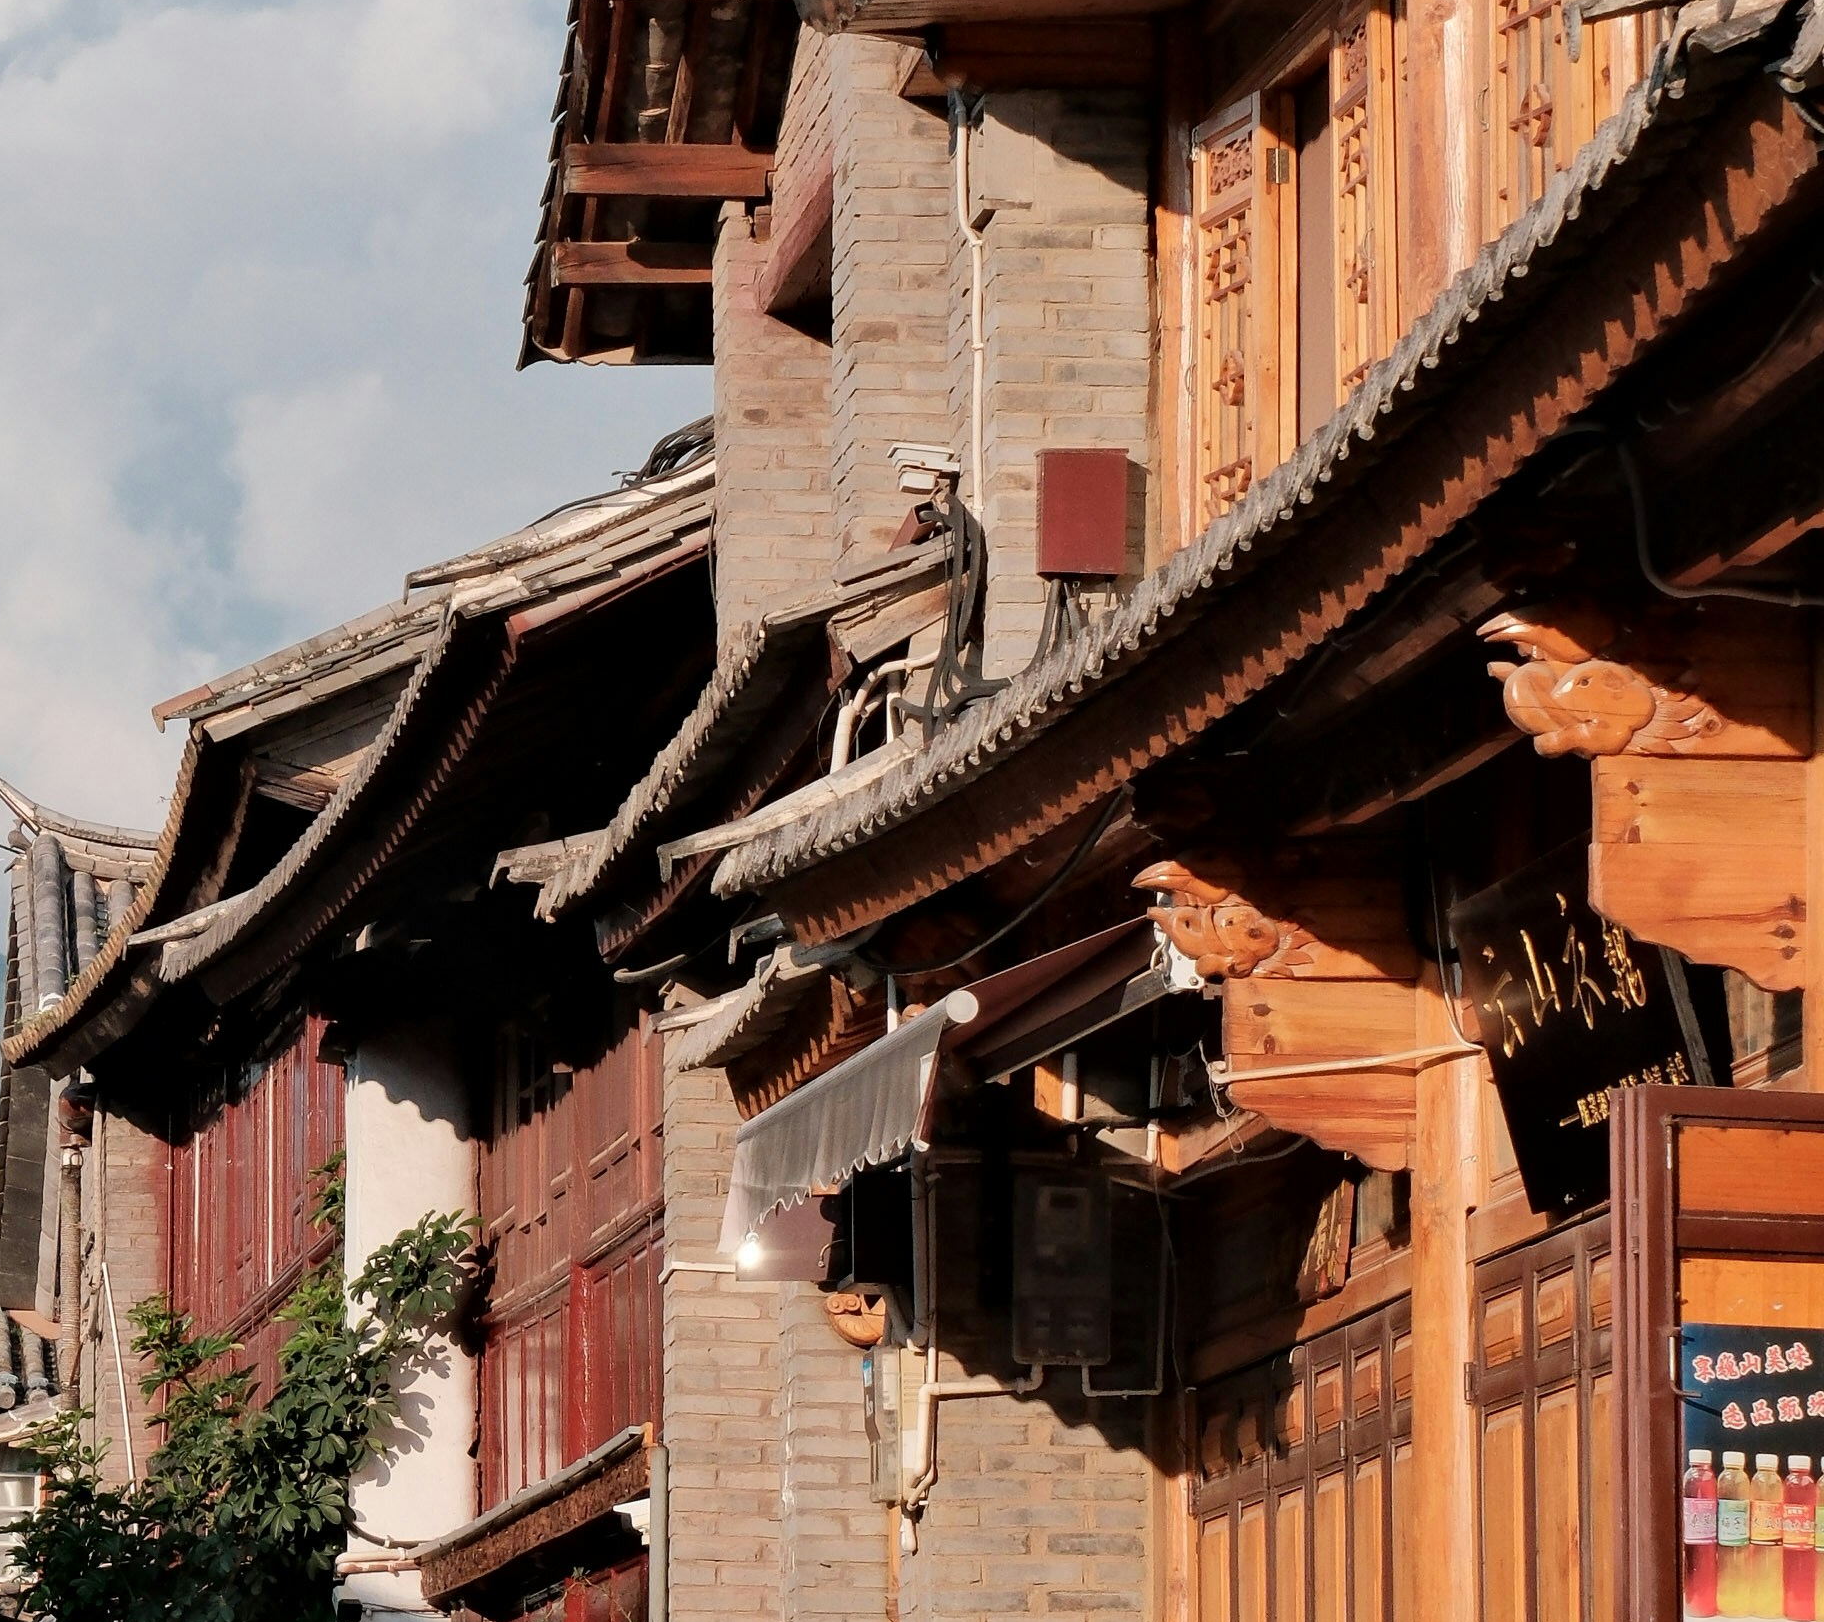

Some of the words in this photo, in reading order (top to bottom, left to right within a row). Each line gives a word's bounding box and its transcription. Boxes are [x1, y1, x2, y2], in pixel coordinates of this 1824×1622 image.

[1692, 1341, 1813, 1384] 享巍山美味
